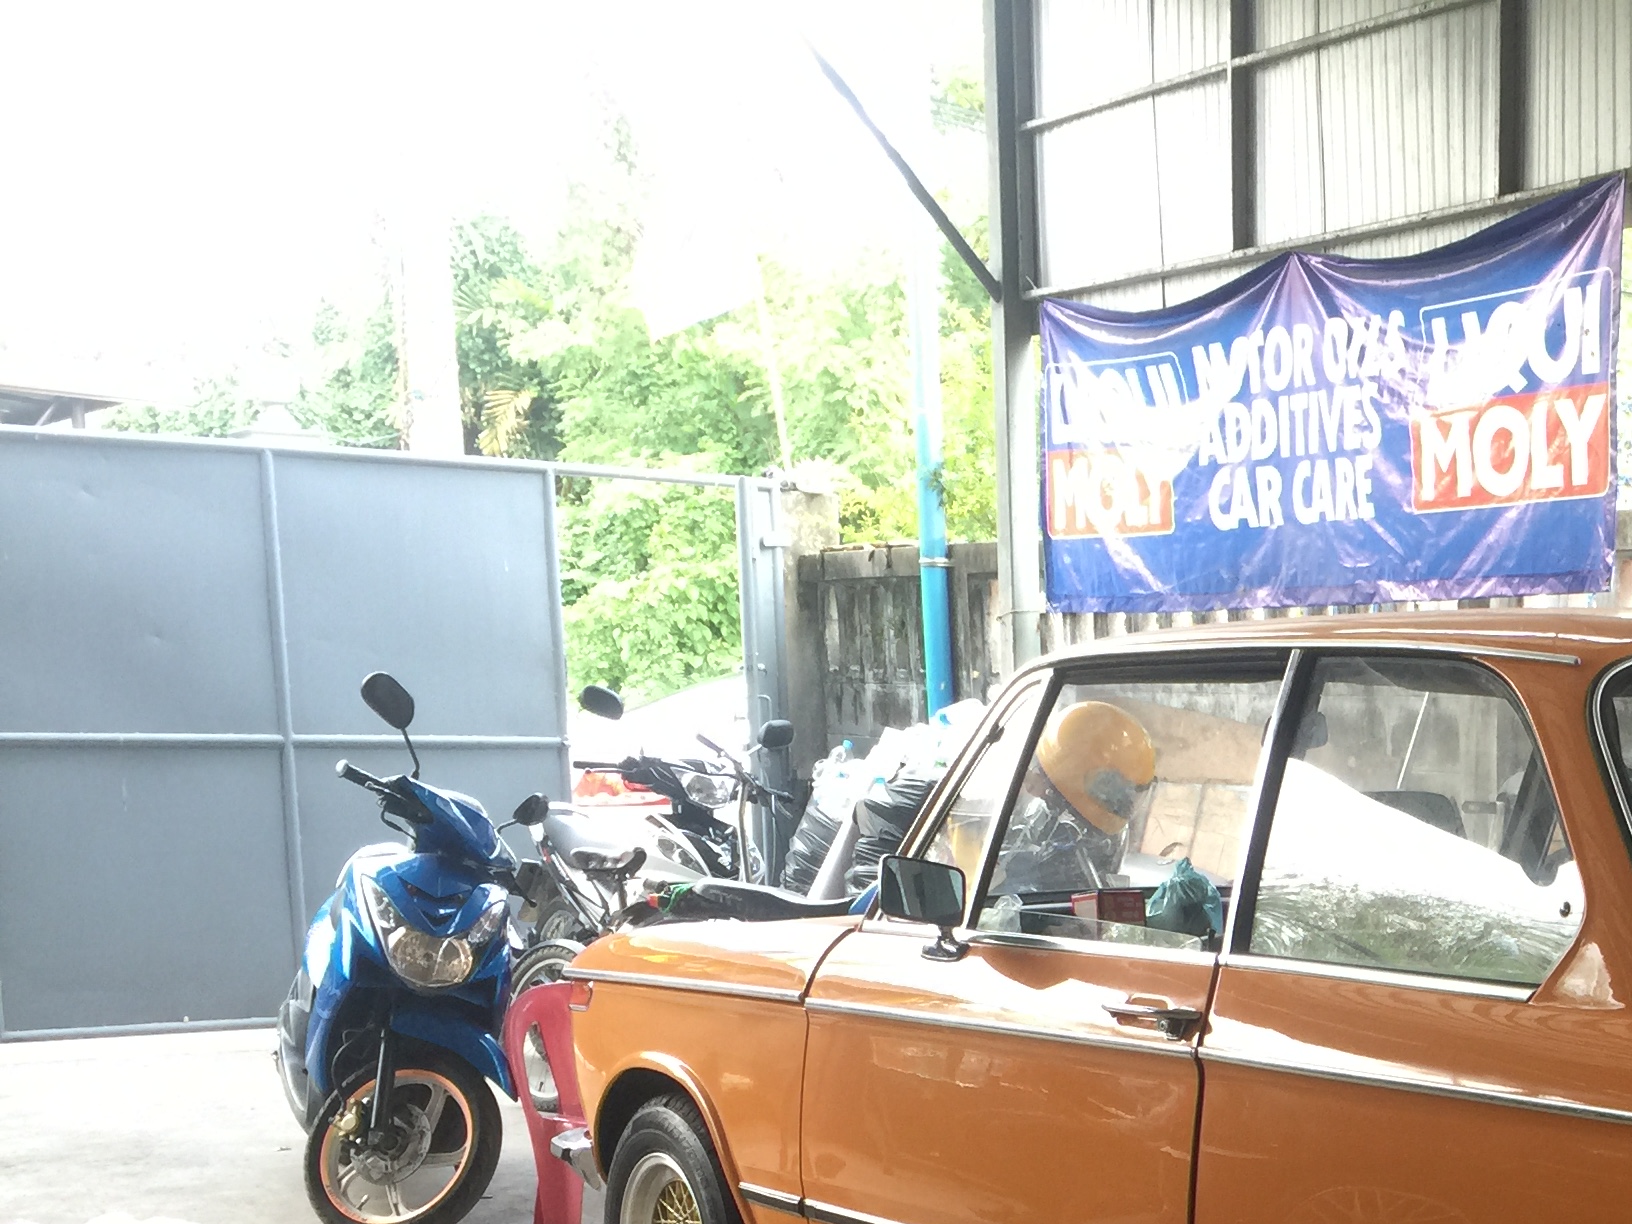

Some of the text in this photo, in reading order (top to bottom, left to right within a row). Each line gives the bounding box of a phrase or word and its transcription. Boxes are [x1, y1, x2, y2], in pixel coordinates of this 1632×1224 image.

[1192, 323, 1316, 402] MOTOR
[1199, 386, 1382, 466] ADDITIVES
[1420, 395, 1607, 501] MOLY
[1053, 454, 1172, 530] MOLY
[1208, 454, 1376, 531] CAR CARE
